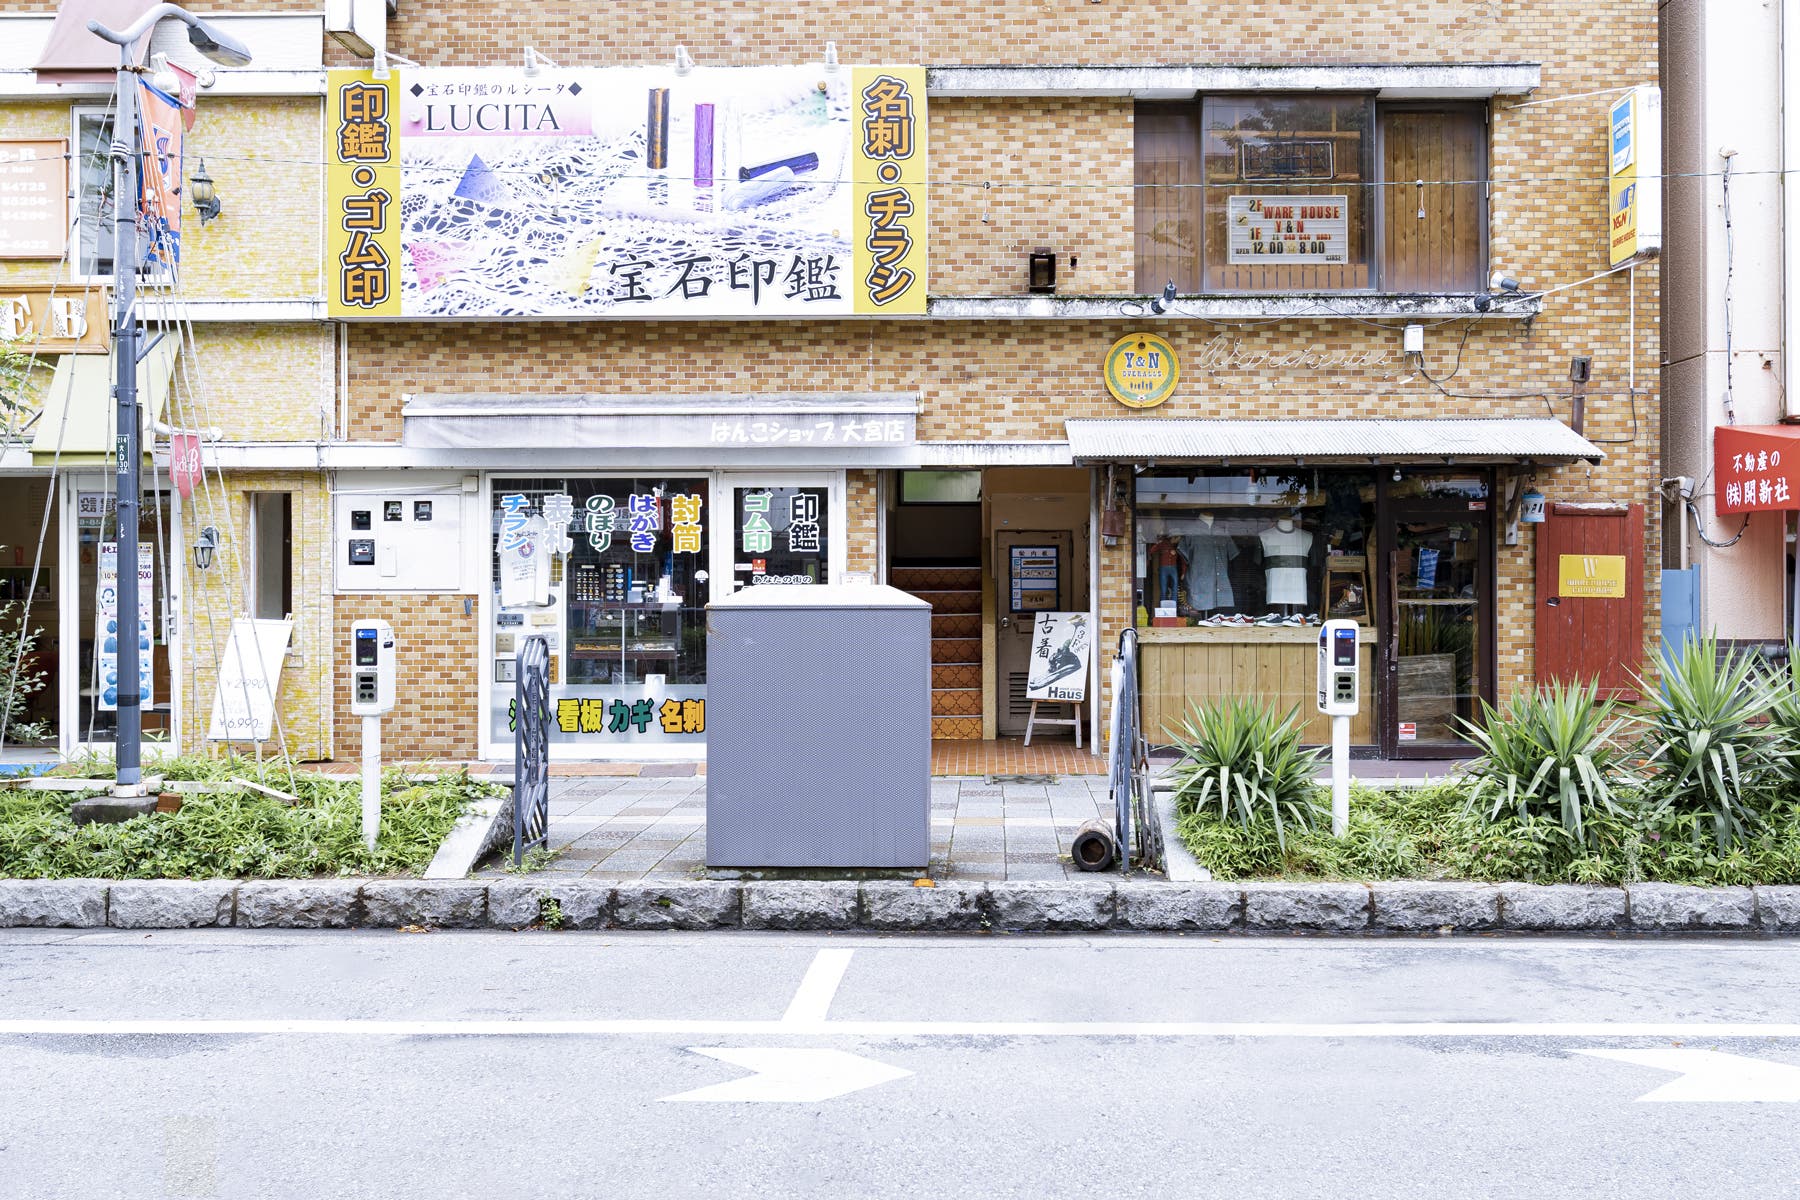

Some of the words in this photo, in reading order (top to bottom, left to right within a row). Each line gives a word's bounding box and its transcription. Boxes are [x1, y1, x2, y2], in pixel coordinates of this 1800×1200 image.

[427, 83, 566, 97] 宝石印鑑のルシータ
[426, 103, 561, 132] LUCITA
[338, 81, 391, 309] 印鑑・ゴム印
[863, 76, 914, 306] 名刺・チラシ
[1249, 199, 1262, 212] 2F
[1264, 206, 1294, 219] WARE
[1301, 206, 1340, 219] HOUSE
[609, 253, 842, 306] 宝石印鑑
[710, 421, 835, 443] はんこショップ
[841, 420, 906, 442] 大宮店
[1732, 449, 1781, 474] 不動産の
[501, 494, 530, 552] チラシ
[543, 494, 573, 553] 表札
[586, 494, 616, 552] のぼり
[629, 494, 660, 552] はがき
[672, 494, 702, 553] 封筒
[743, 492, 773, 552] ゴム印
[789, 493, 820, 552] 印鑑
[1036, 613, 1058, 659] 古着
[556, 698, 604, 733] 看板
[609, 698, 654, 733] カギ
[659, 698, 706, 733] 名刺
[1048, 686, 1082, 699] Haus
